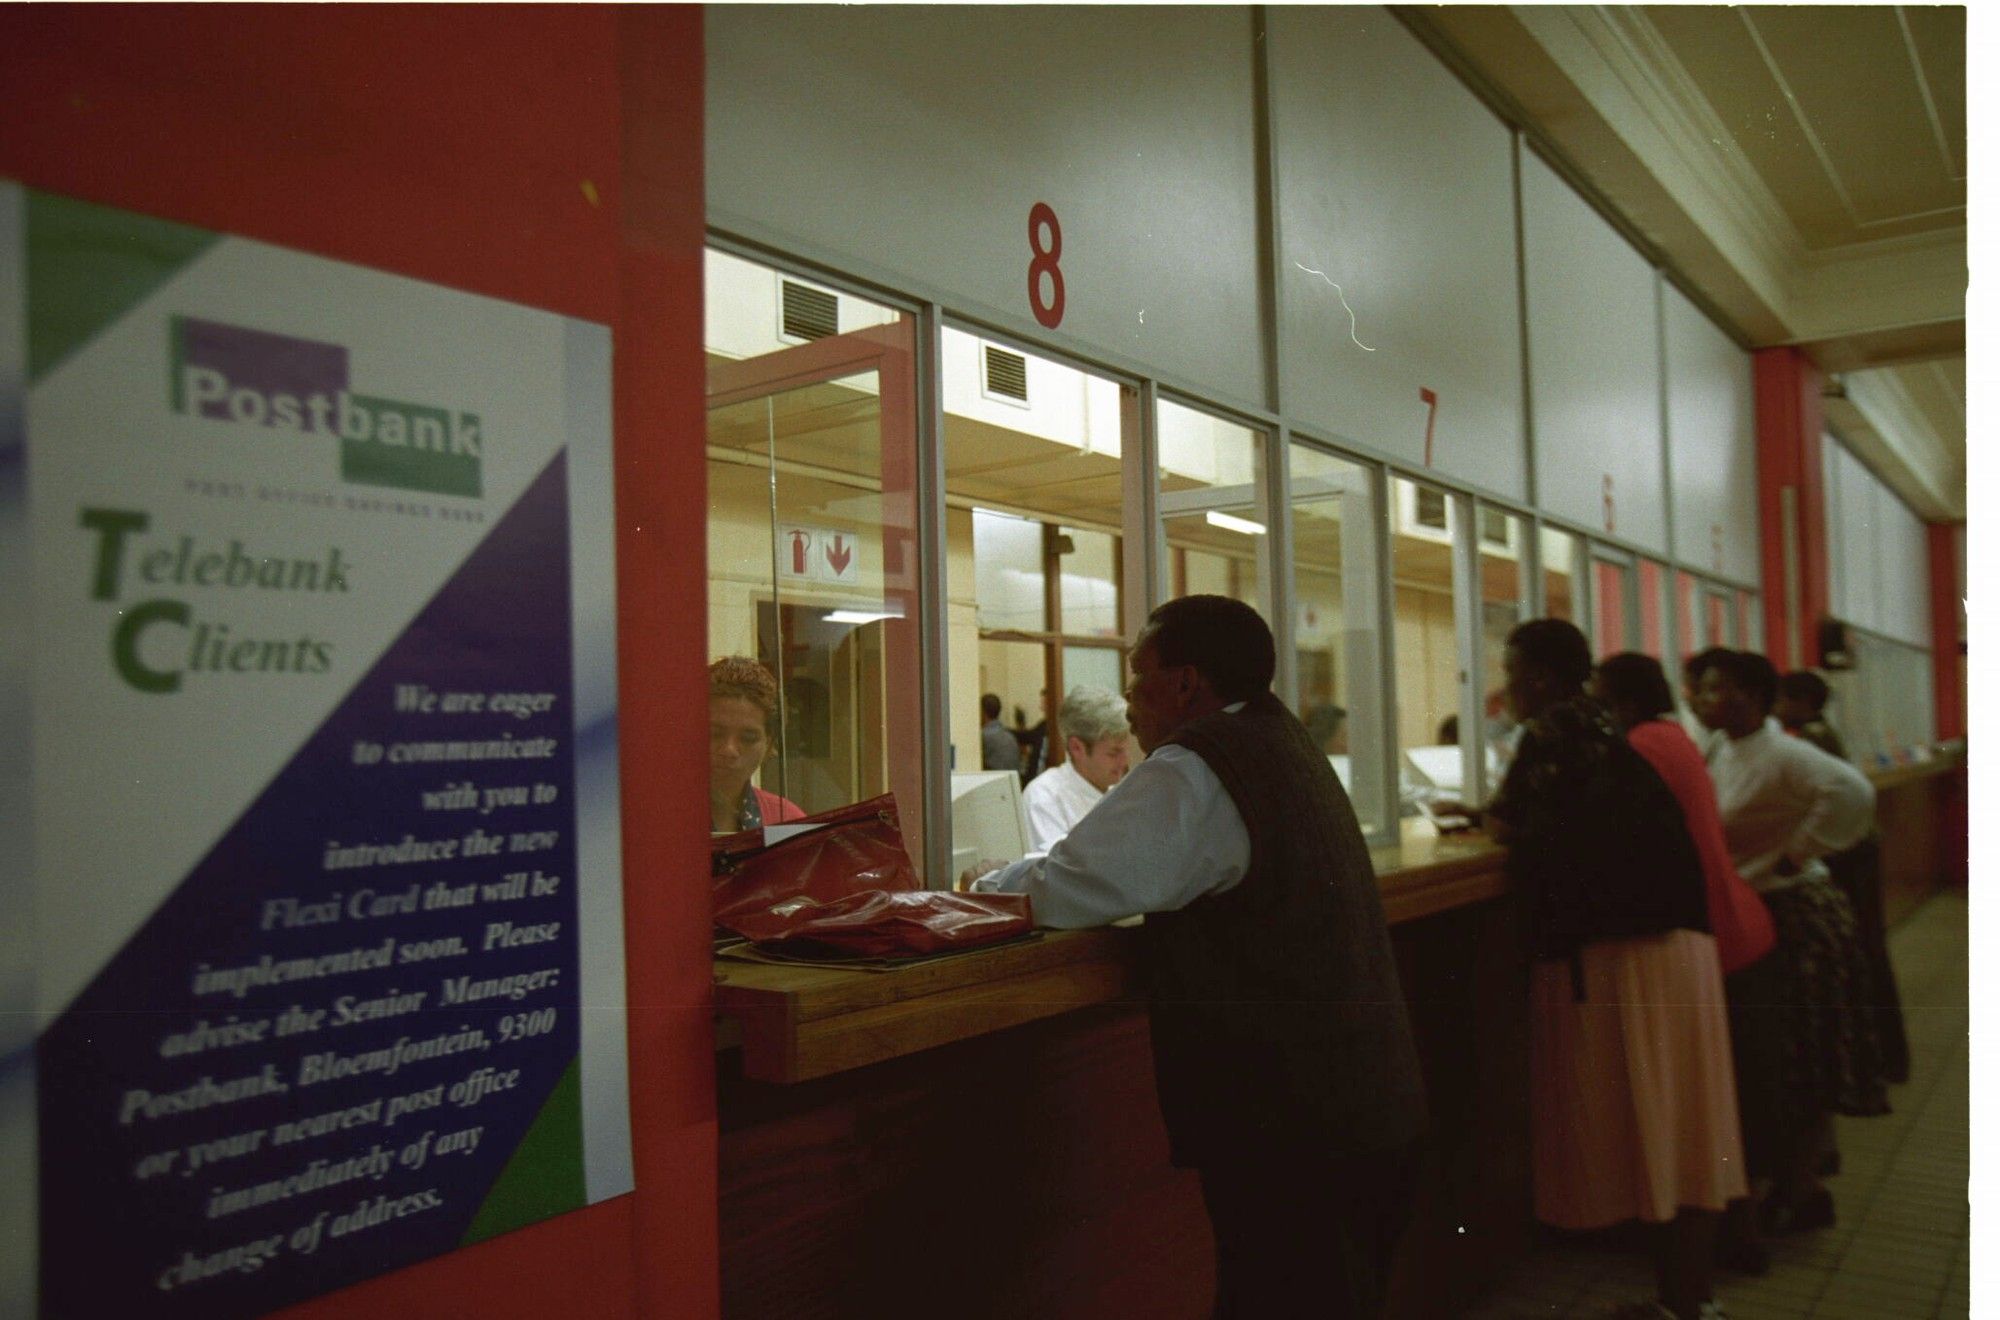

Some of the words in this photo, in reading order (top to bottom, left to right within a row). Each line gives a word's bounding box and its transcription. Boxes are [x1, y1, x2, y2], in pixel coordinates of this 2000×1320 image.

[1027, 201, 1065, 329] 8
[182, 366, 481, 459] Postbank
[1419, 387, 1437, 468] 7
[79, 507, 353, 601] Telebank
[111, 599, 334, 694] Clients
[394, 684, 438, 714] We
[440, 691, 486, 713] are
[489, 690, 556, 719] eager
[352, 740, 384, 765] to
[388, 733, 558, 763] communicate
[421, 782, 478, 811] with
[480, 785, 528, 813] you
[532, 783, 557, 804] to
[323, 835, 458, 870] introduce
[462, 830, 503, 856] the
[509, 832, 559, 853] new
[260, 893, 341, 931] Flexi
[347, 884, 420, 920] Card
[423, 881, 478, 910] that
[482, 873, 526, 902] will
[531, 871, 560, 896] be
[193, 938, 394, 998] implemented
[398, 938, 468, 964] soon.
[484, 921, 560, 952] Please
[160, 1011, 271, 1058] advise
[275, 1004, 325, 1037] the
[331, 990, 428, 1028] Senior
[440, 968, 560, 1007] Manager:
[119, 1064, 289, 1125] Postbank,
[298, 1025, 491, 1086] Bloemfontein,
[498, 1006, 556, 1044] 9300
[134, 1150, 180, 1180] or
[182, 1131, 268, 1176] your
[273, 1096, 385, 1144] nearest
[384, 1086, 446, 1128] post
[448, 1066, 520, 1105] office
[204, 1140, 398, 1220] immediately
[399, 1131, 431, 1168] of
[434, 1122, 483, 1158] any
[155, 1235, 284, 1291] change
[289, 1211, 327, 1254] of
[330, 1186, 443, 1239] address.
